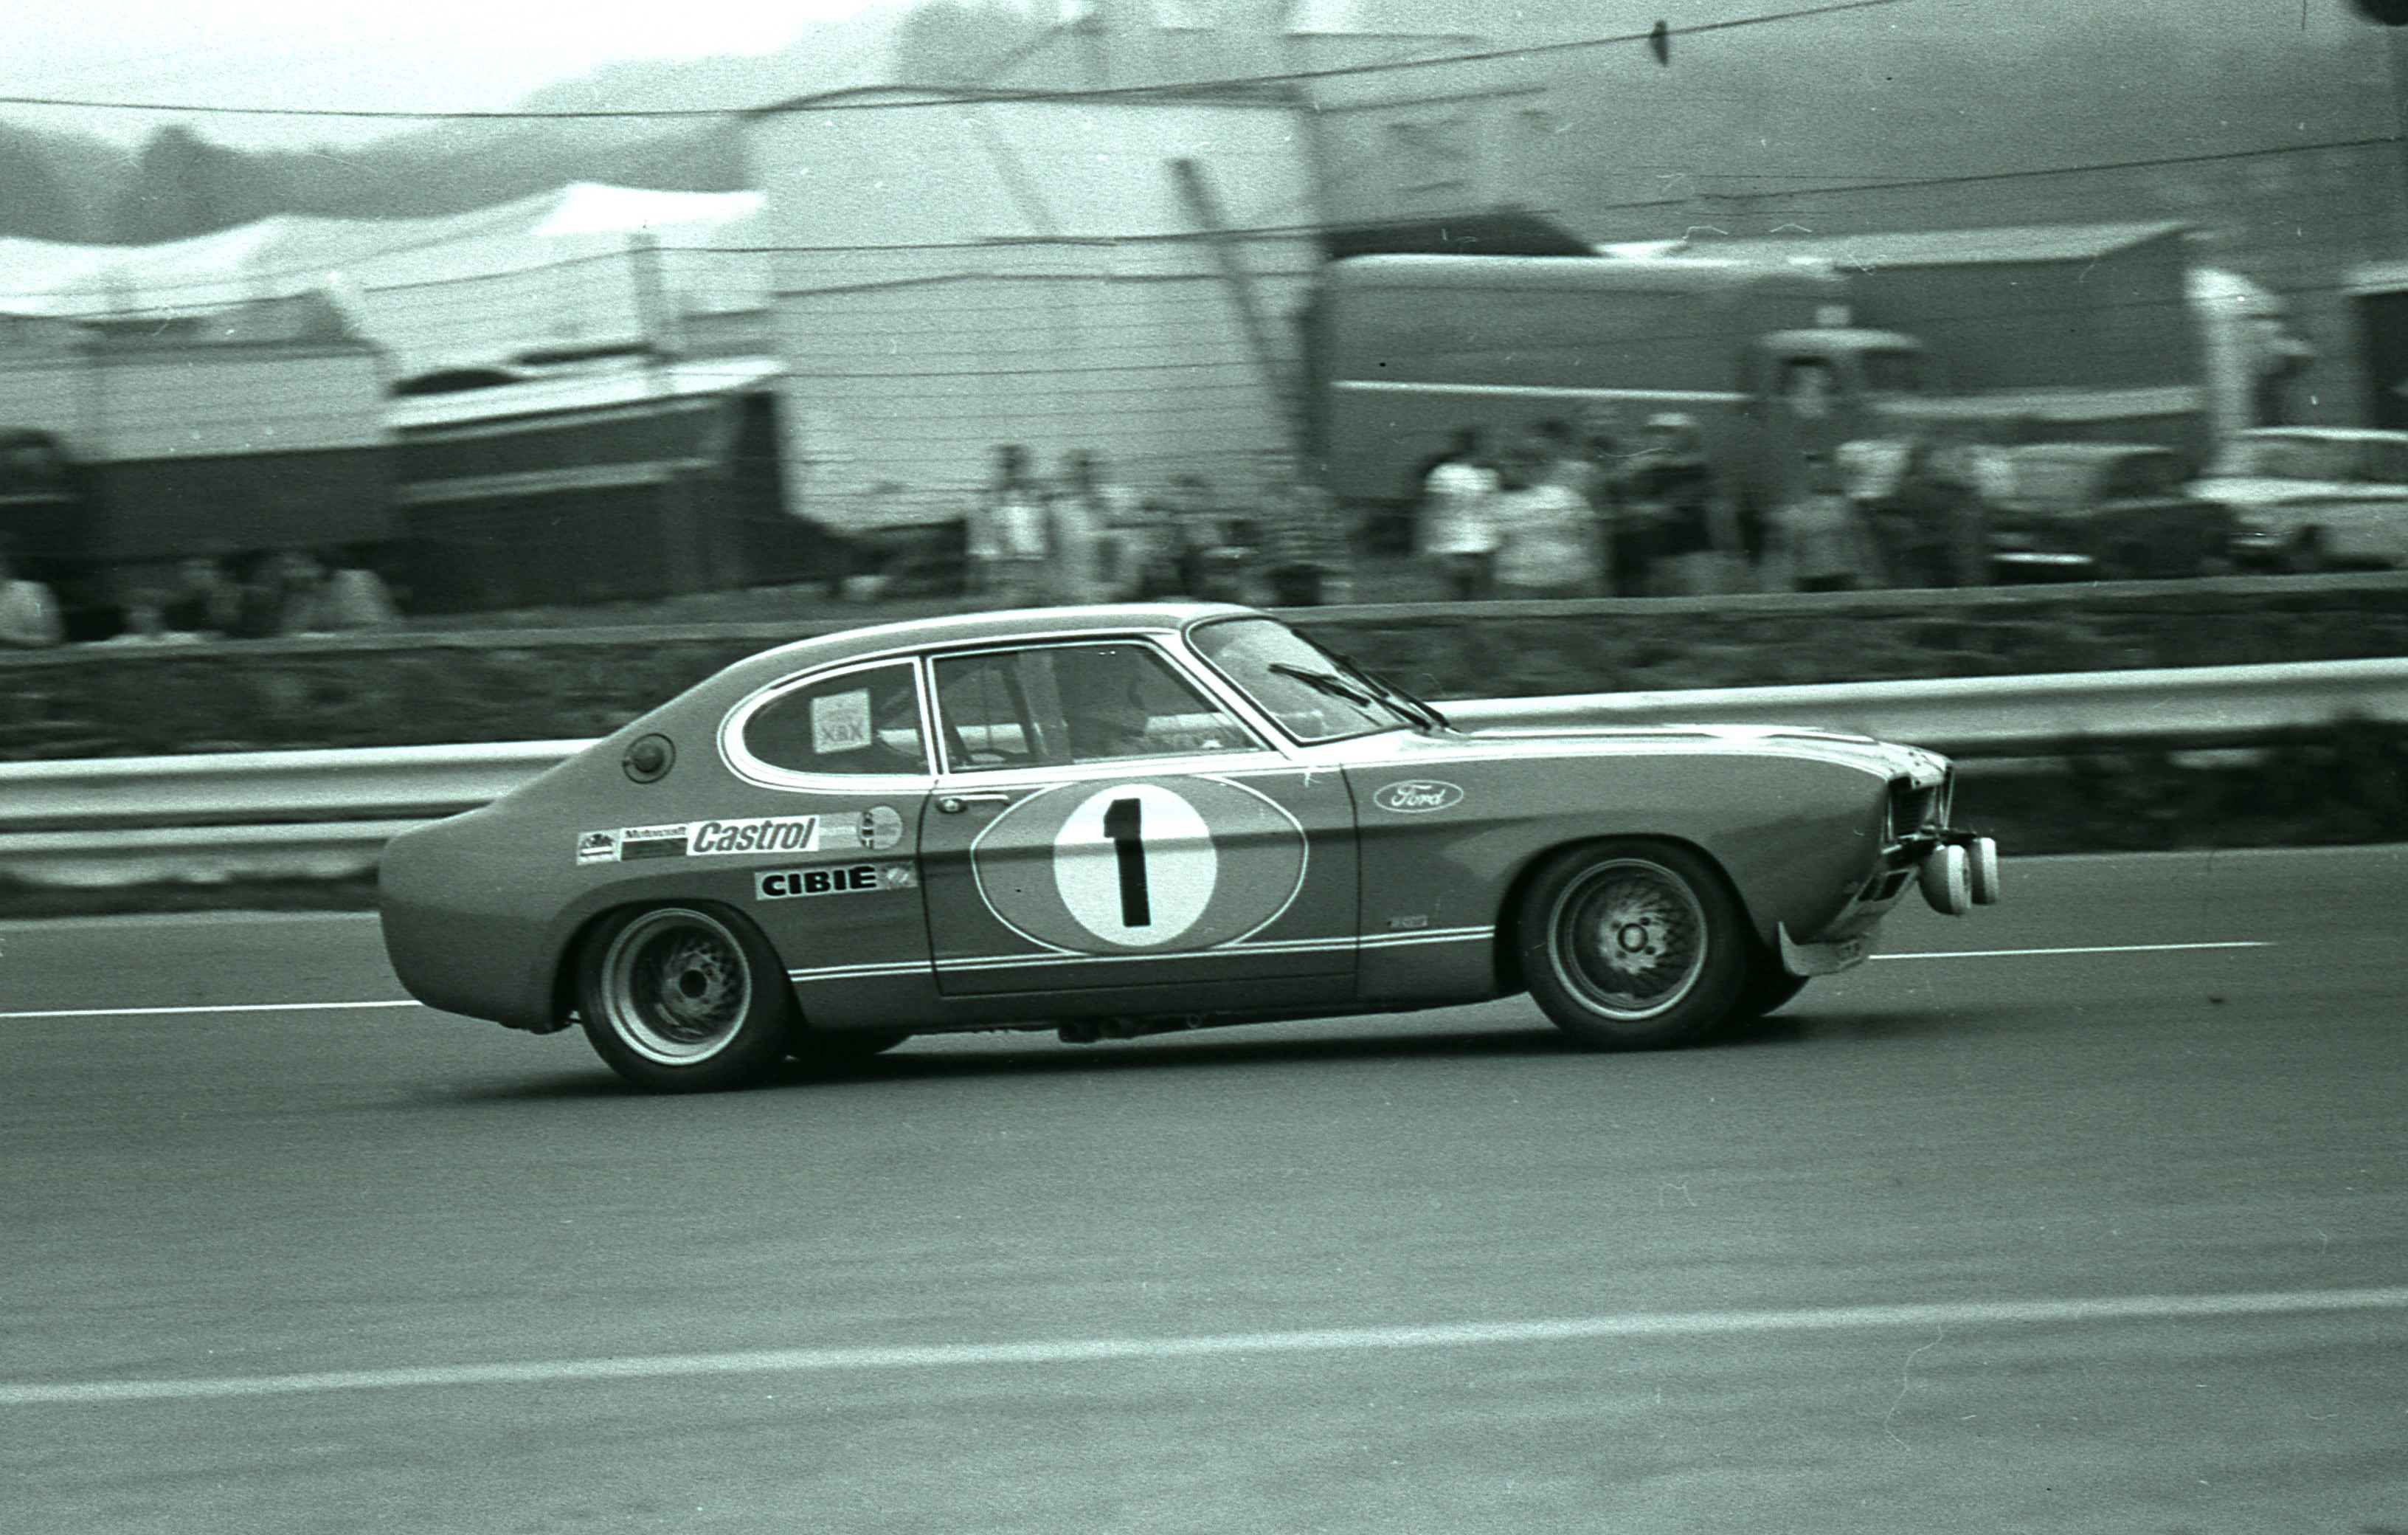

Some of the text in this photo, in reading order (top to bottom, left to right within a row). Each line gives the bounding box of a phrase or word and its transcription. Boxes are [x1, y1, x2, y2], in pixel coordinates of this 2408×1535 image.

[1391, 784, 1446, 807] Ford
[693, 817, 816, 853] Castrol
[1104, 798, 1151, 927] 1
